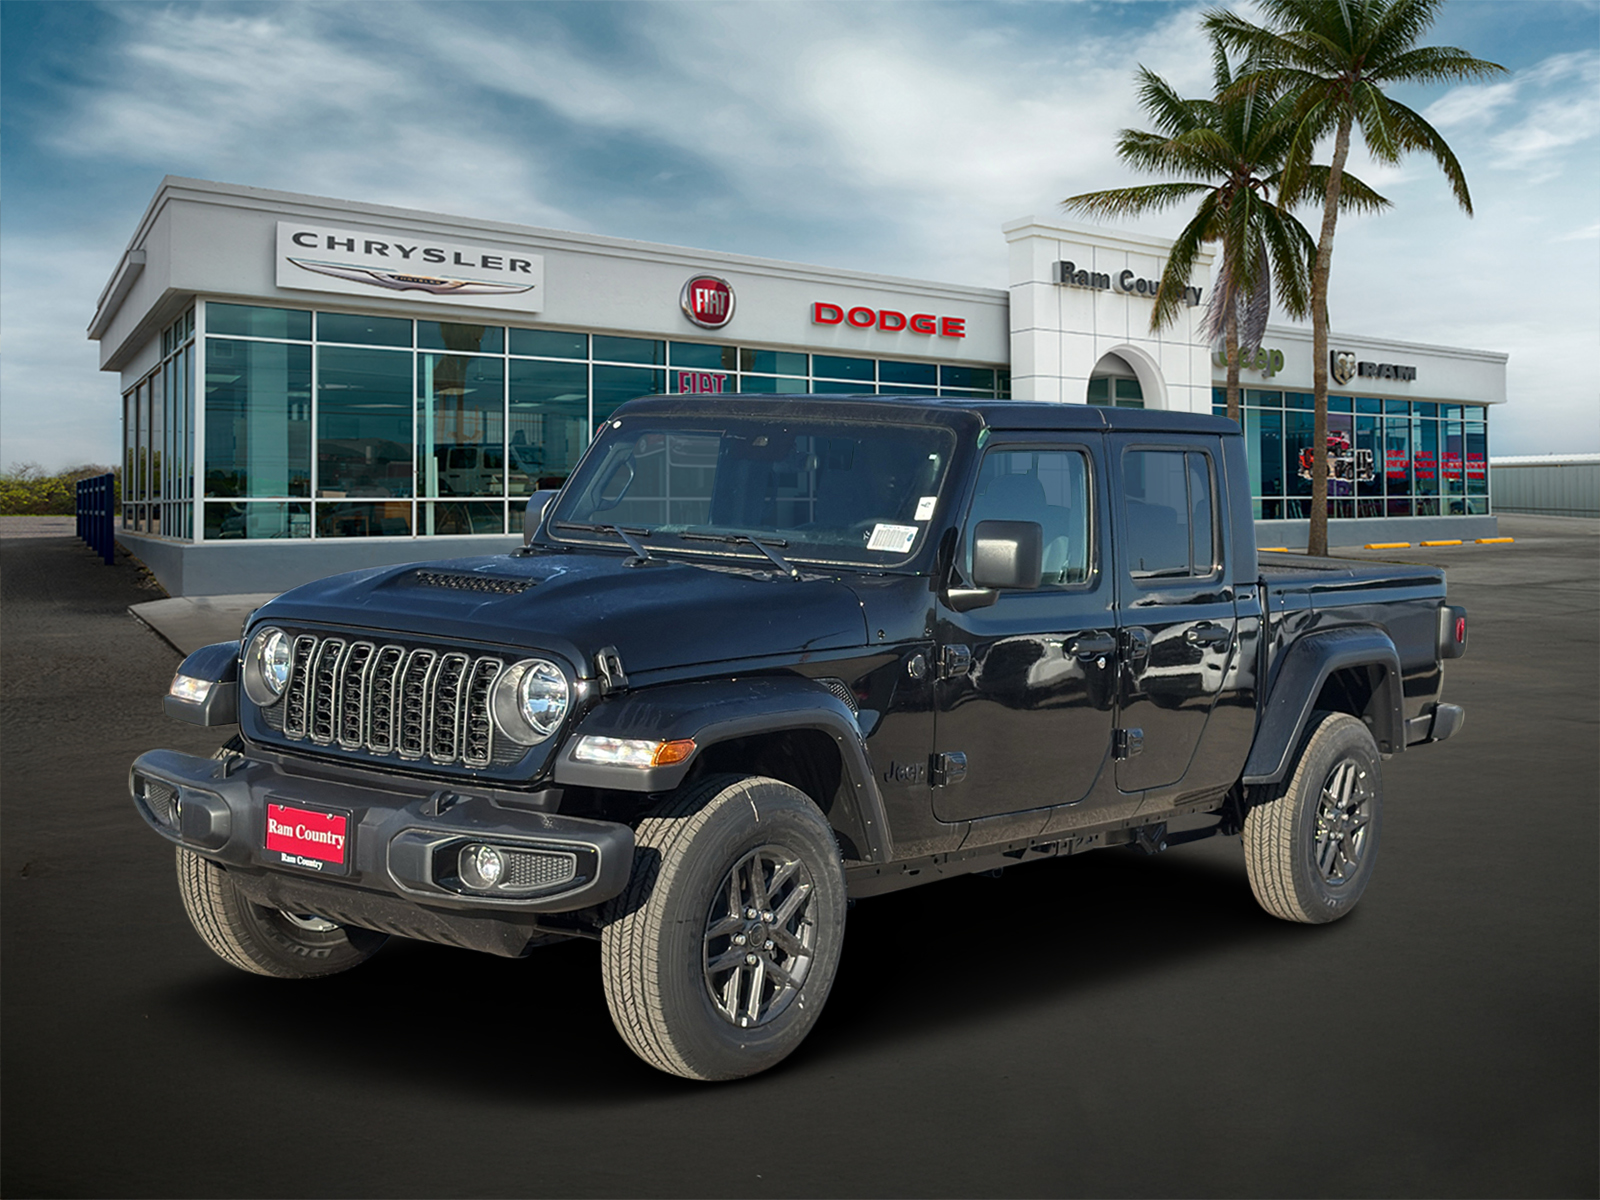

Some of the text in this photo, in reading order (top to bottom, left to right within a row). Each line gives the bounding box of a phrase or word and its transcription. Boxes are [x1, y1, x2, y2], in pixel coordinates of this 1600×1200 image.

[292, 231, 533, 274] CHRYSLER
[1058, 260, 1204, 307] Ram Coury
[695, 287, 728, 317] FIAT
[813, 301, 967, 339] DODGE
[677, 371, 727, 394] FIAT
[1358, 361, 1417, 382] RAM
[884, 761, 925, 783] Jeep
[268, 818, 345, 850] Ram Country
[281, 852, 323, 871] Ram Country
